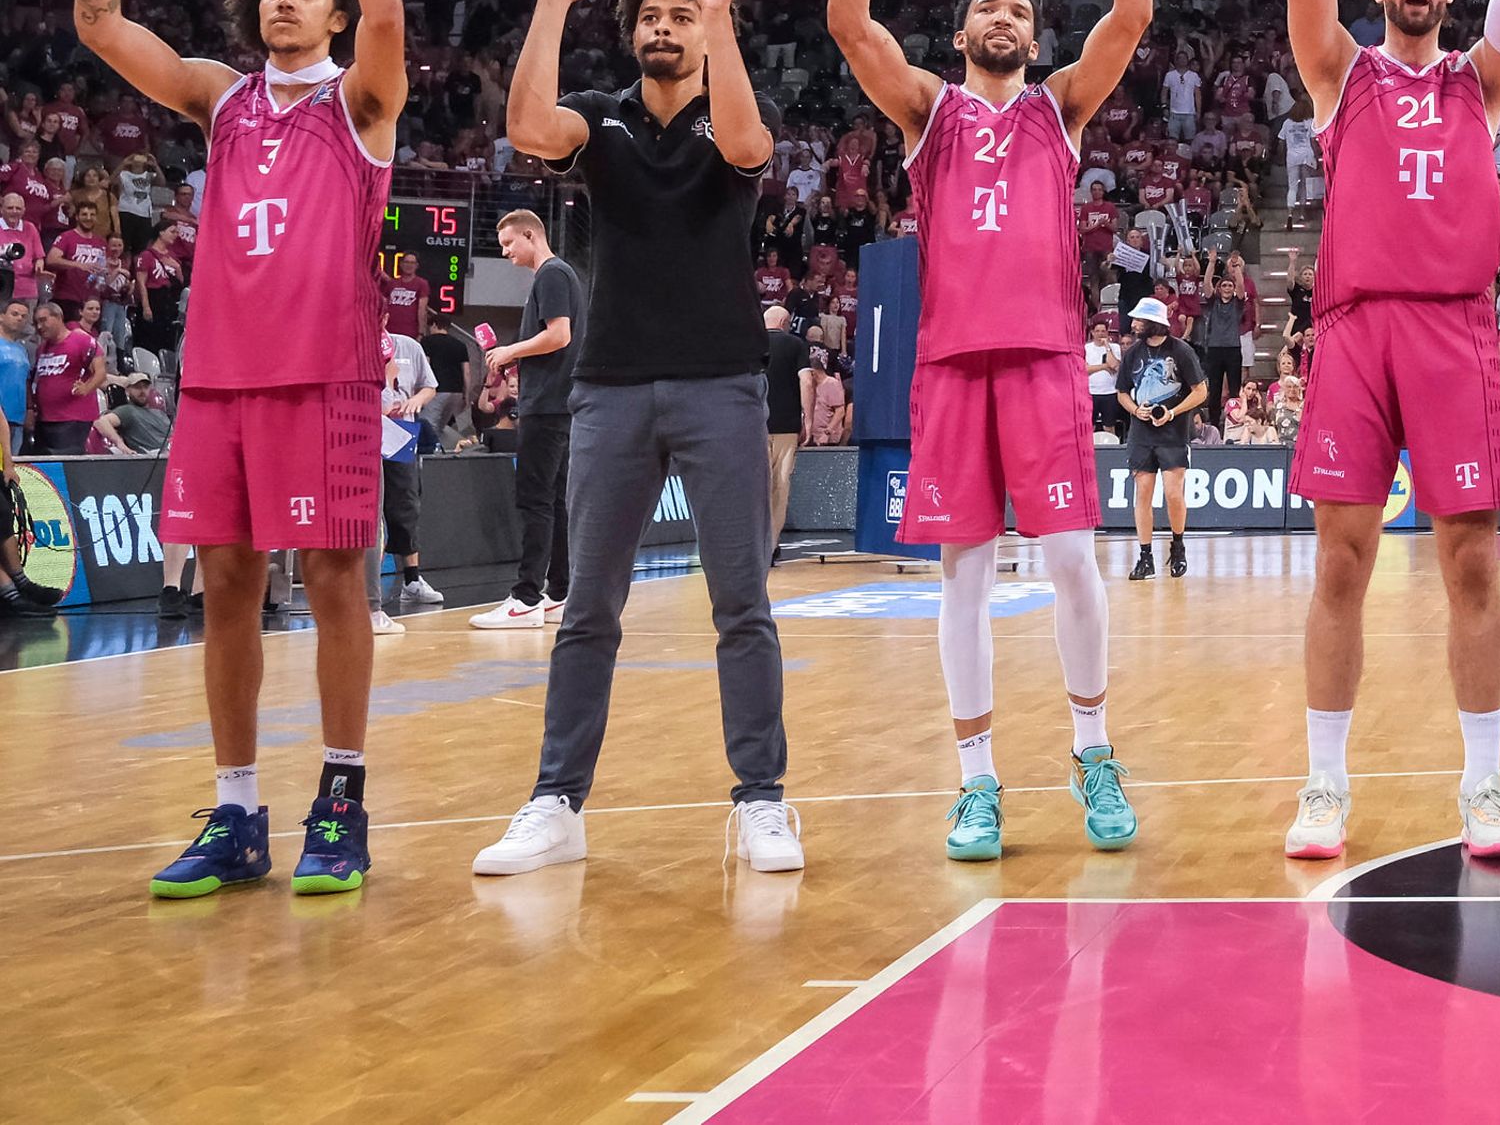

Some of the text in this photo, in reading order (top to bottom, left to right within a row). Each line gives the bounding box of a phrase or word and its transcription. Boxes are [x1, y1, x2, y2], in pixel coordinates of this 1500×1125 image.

[1396, 92, 1443, 129] 21
[1398, 147, 1445, 200] T
[237, 198, 288, 256] T
[426, 207, 456, 235] 75
[440, 285, 456, 313] 5
[1455, 462, 1480, 490] T
[1047, 481, 1073, 510] T
[290, 496, 316, 525] T
[917, 514, 951, 523] SPALDING
[79, 493, 165, 567] 10X
